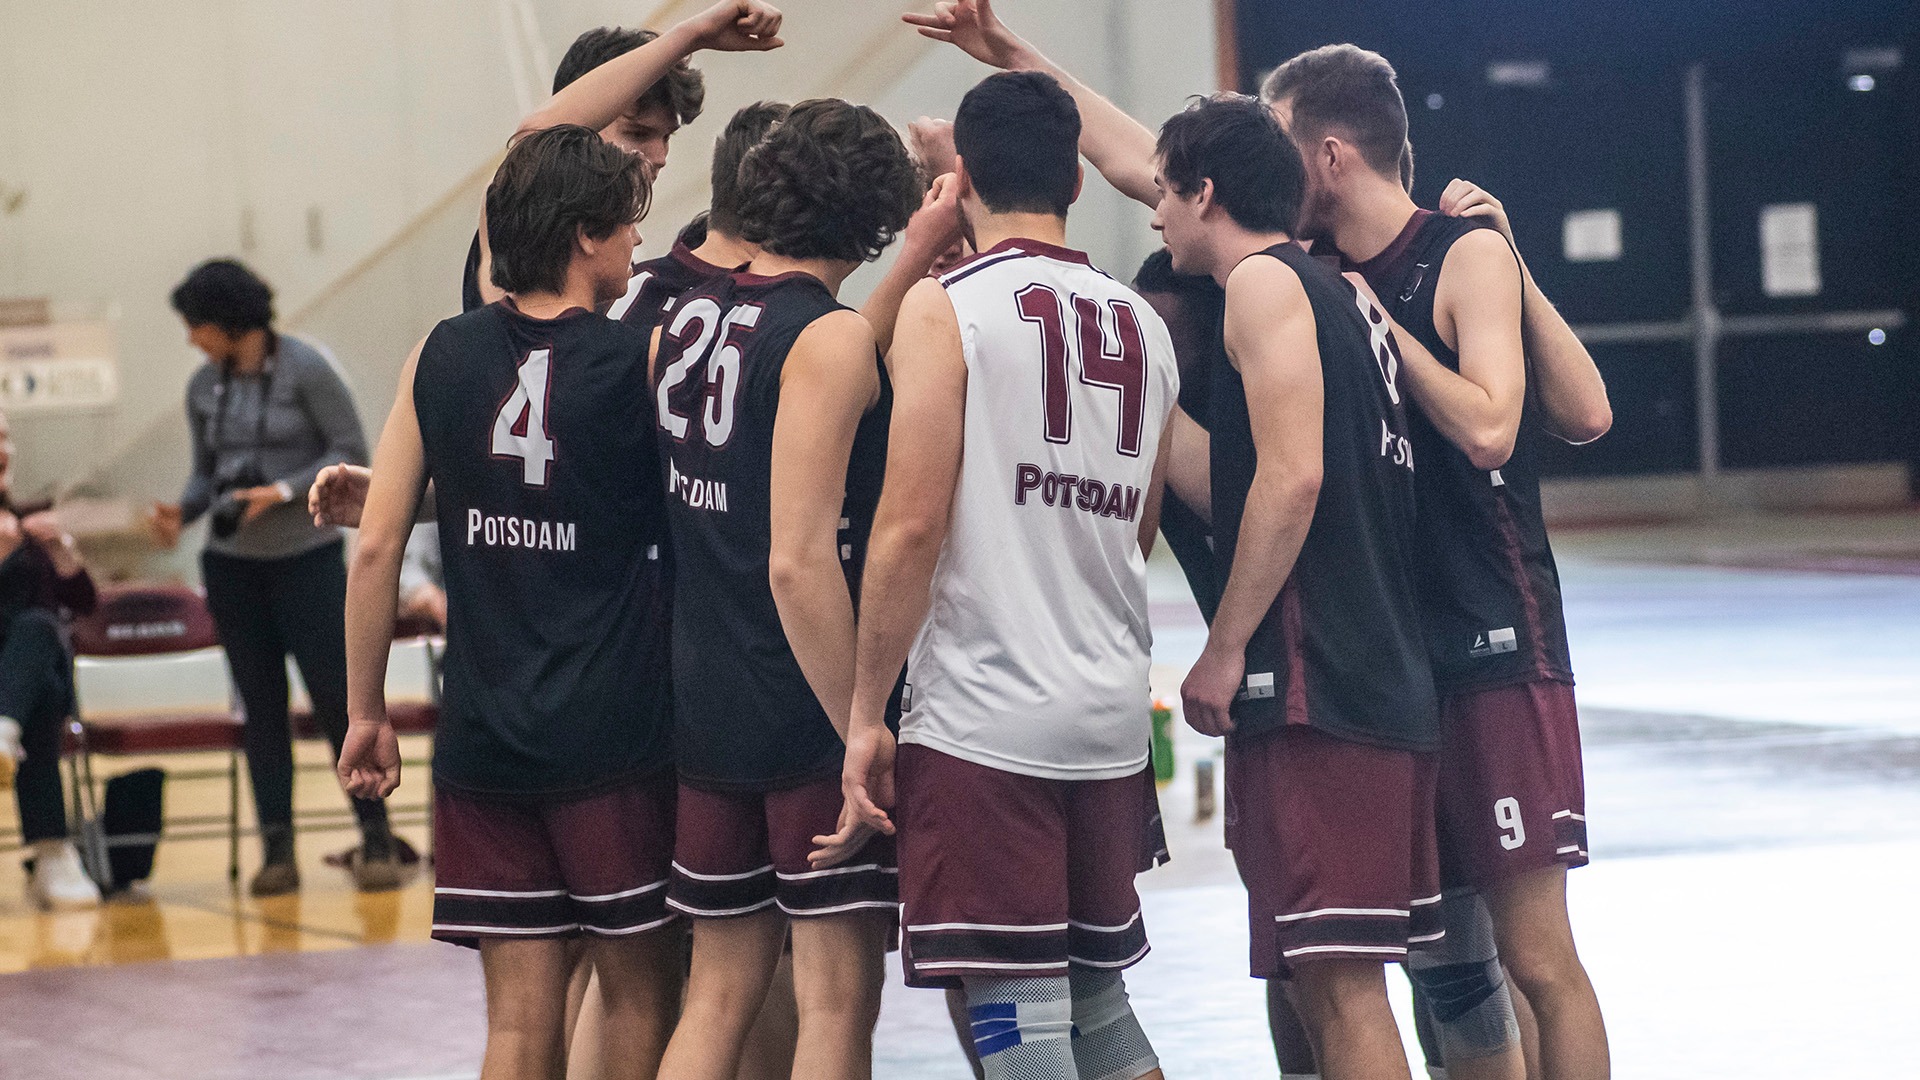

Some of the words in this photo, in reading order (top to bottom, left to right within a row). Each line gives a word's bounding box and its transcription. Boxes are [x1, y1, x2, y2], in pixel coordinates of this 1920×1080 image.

[490, 346, 556, 487] 4
[656, 297, 763, 448] 25
[1014, 282, 1148, 458] 14
[466, 508, 577, 551] POTSDAM
[1015, 463, 1141, 522] POTSDAM
[1493, 796, 1526, 851] 9
